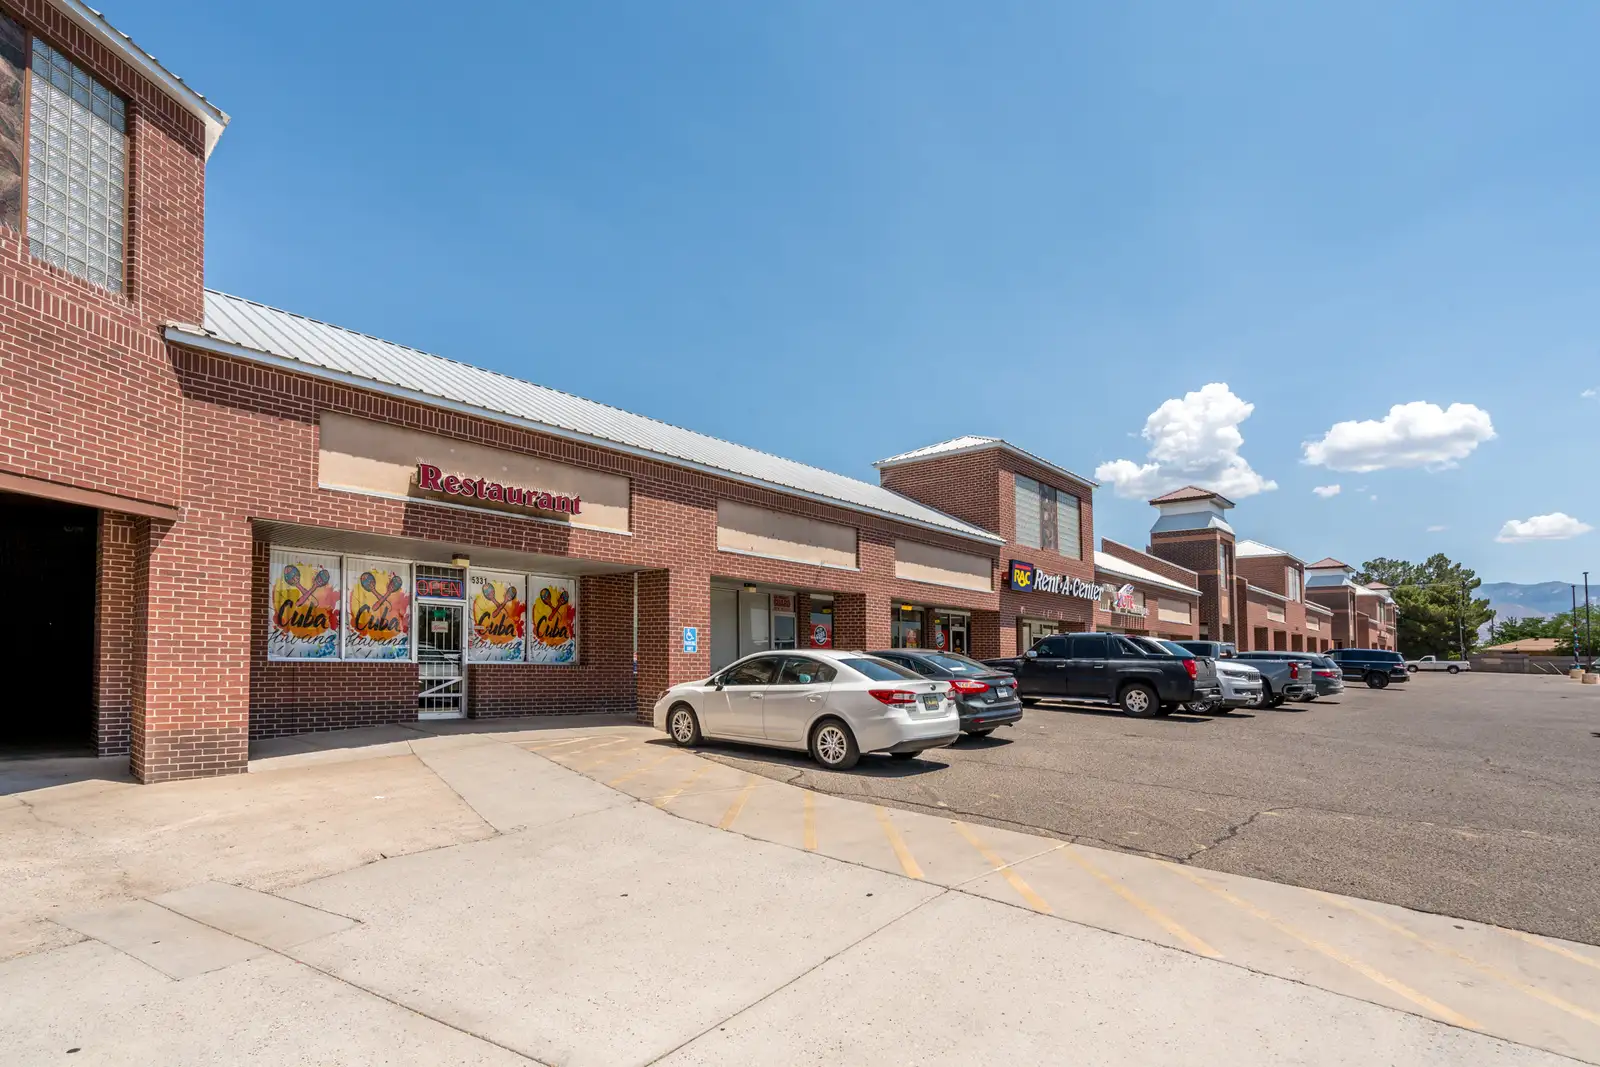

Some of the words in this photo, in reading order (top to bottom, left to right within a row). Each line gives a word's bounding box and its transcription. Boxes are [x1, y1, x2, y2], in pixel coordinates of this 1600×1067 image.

[418, 463, 582, 515] Restaurant
[470, 576, 488, 585] 5331
[1014, 568, 1031, 587] RAC
[416, 579, 461, 597] OPEN
[277, 599, 329, 629] Cuba
[355, 604, 401, 632] Cuba
[478, 611, 516, 637] Cuba
[268, 629, 338, 645] Havana
[536, 616, 569, 638] Cuba
[344, 631, 409, 647] Havana
